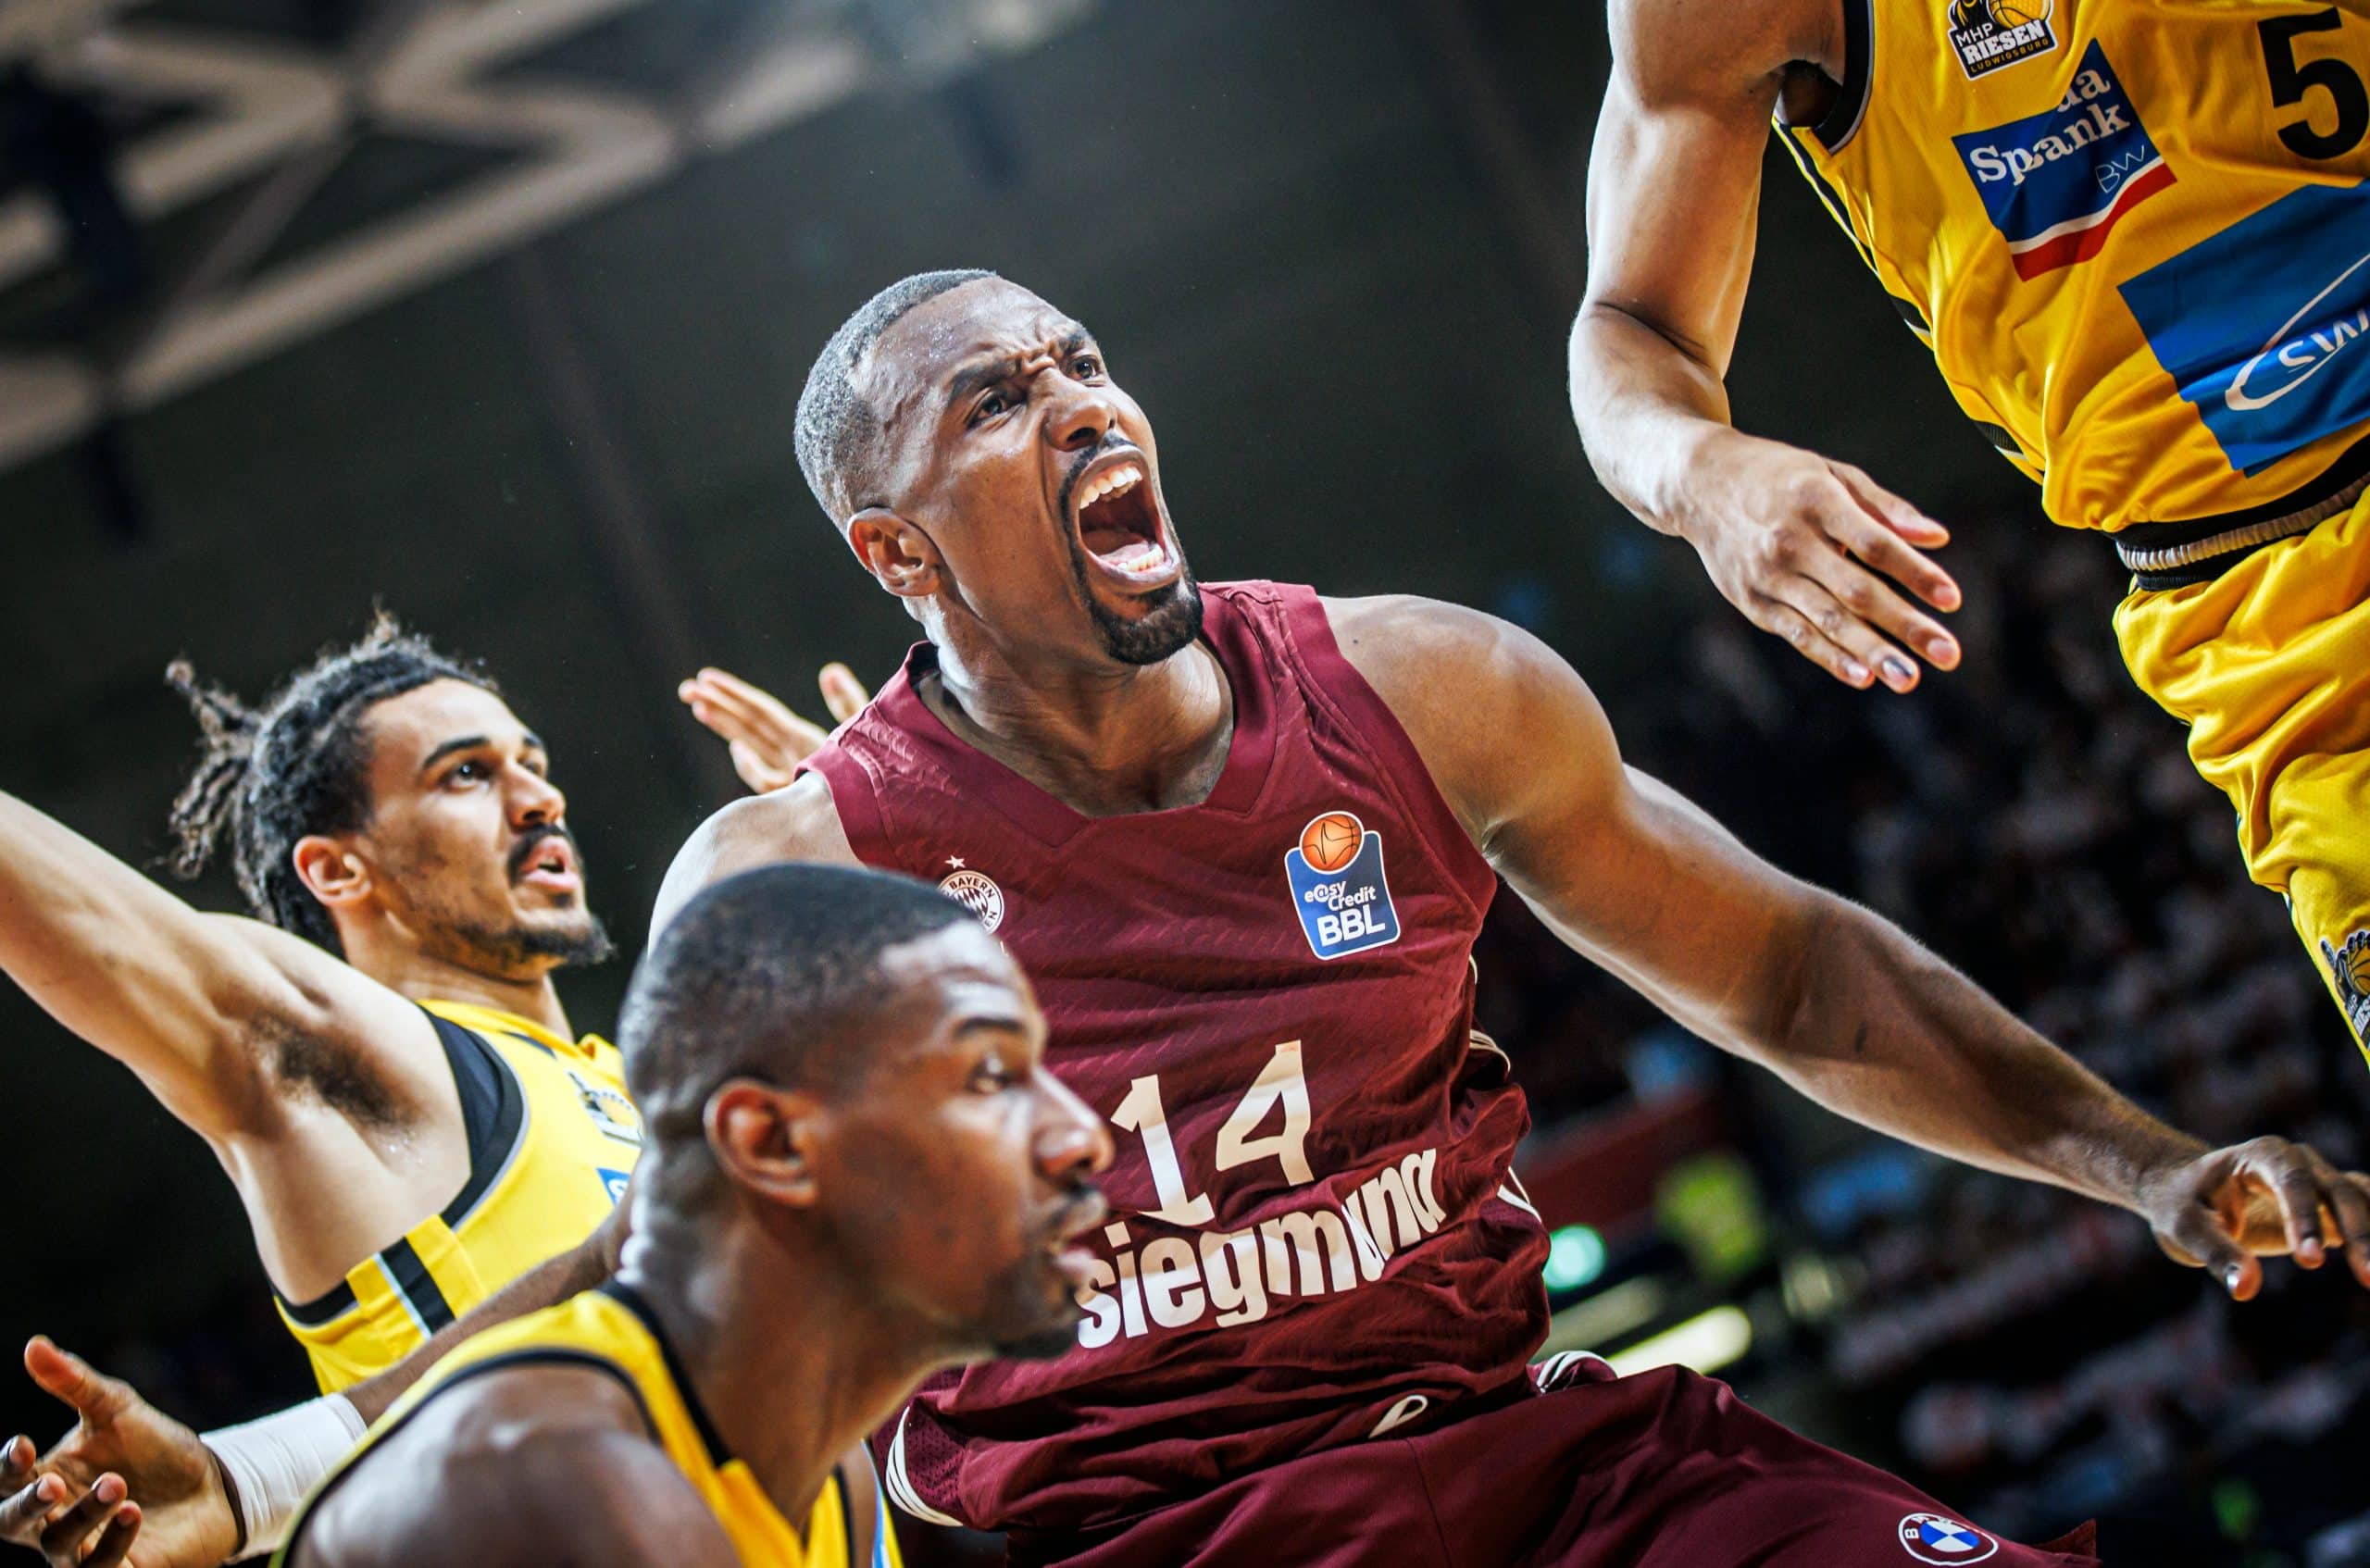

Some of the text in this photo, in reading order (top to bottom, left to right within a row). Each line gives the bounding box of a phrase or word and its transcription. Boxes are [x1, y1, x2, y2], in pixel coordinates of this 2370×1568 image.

[1955, 22, 1994, 47] MHP
[1962, 19, 2046, 66] RIESEN
[1969, 38, 2050, 73] LUDWIGSBURG
[2095, 144, 2145, 193] BW
[948, 876, 996, 899] BAYERN
[1304, 880, 1378, 912] e@sy Credit
[1316, 904, 1386, 947] BBL
[1110, 1039, 1315, 1227] 14
[1074, 1148, 1447, 1350] siegmund
